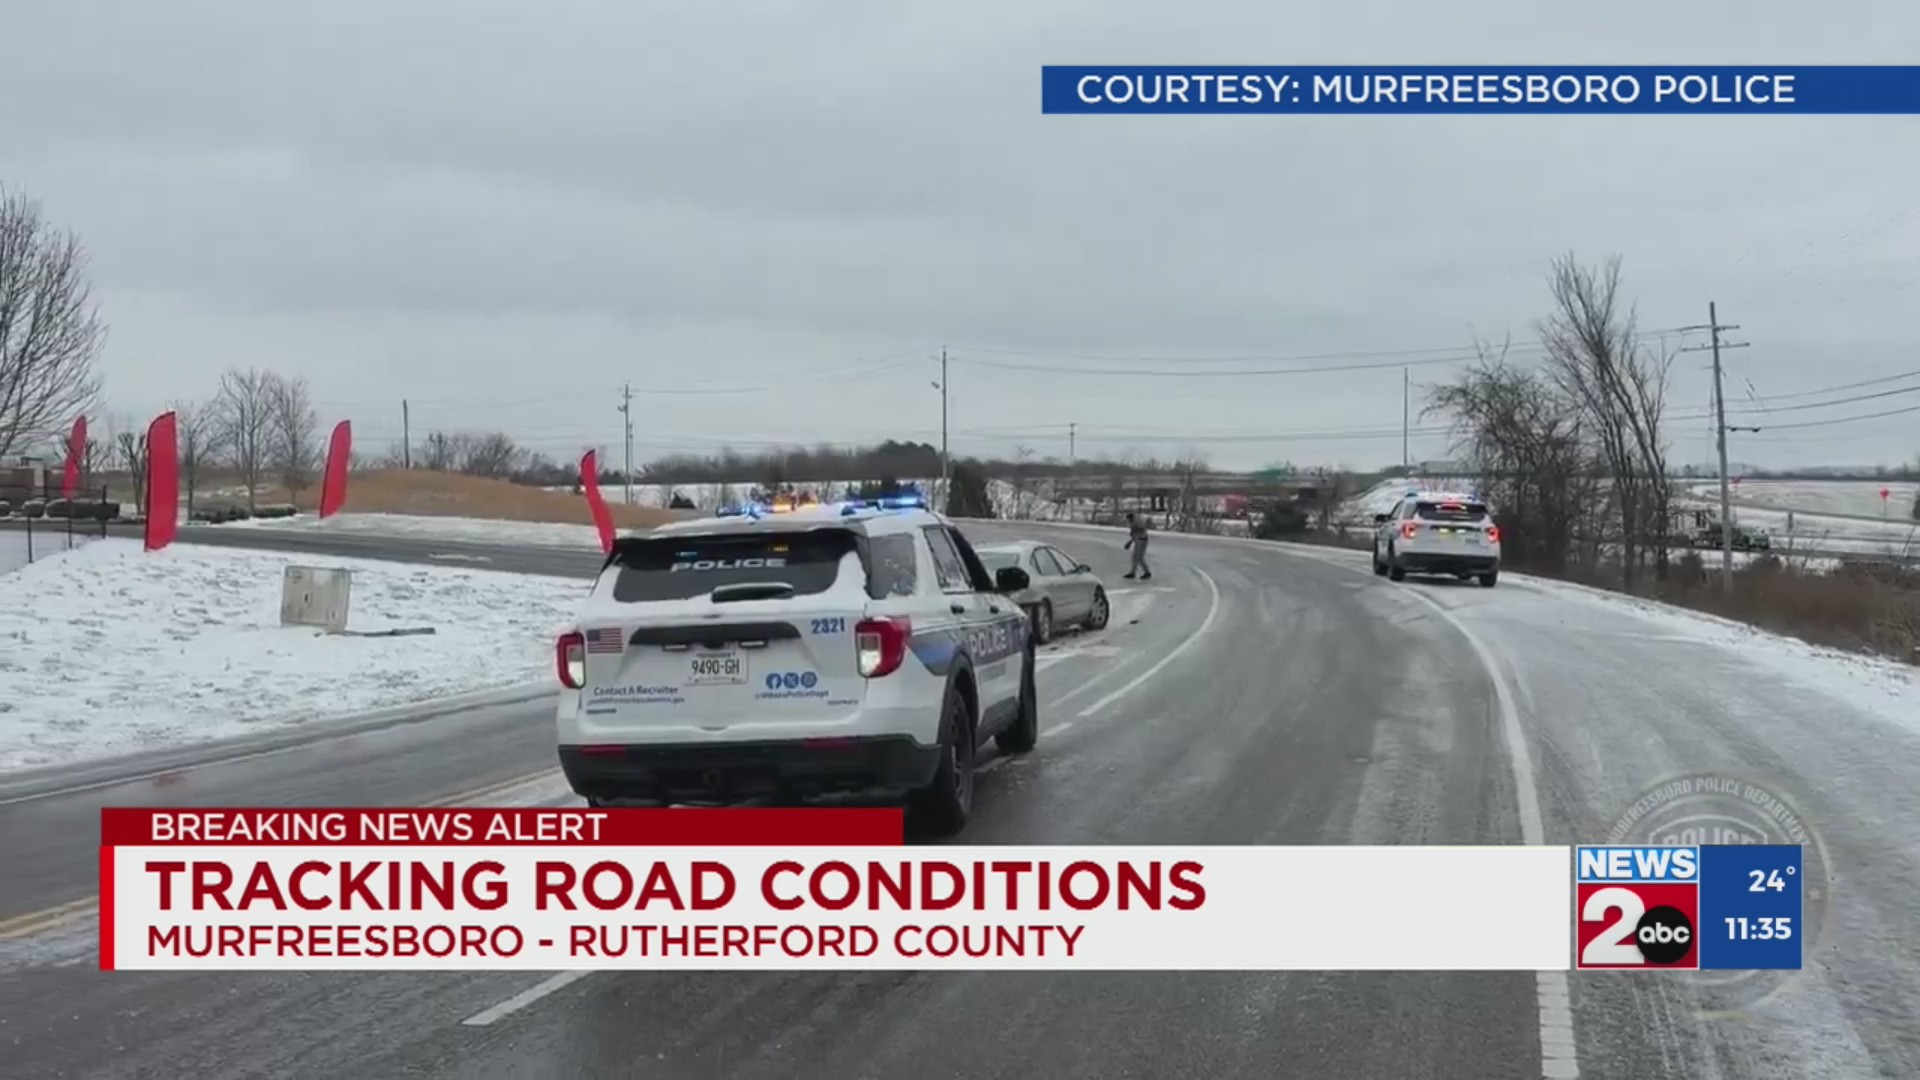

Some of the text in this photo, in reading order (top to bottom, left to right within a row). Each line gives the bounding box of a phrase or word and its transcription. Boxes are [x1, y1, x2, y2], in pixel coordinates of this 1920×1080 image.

[671, 558, 786, 572] POLICE
[811, 617, 845, 635] 2321
[970, 628, 1006, 657] POLICE
[691, 658, 740, 676] 9490-GH
[593, 684, 678, 696] Contact A Recruiter
